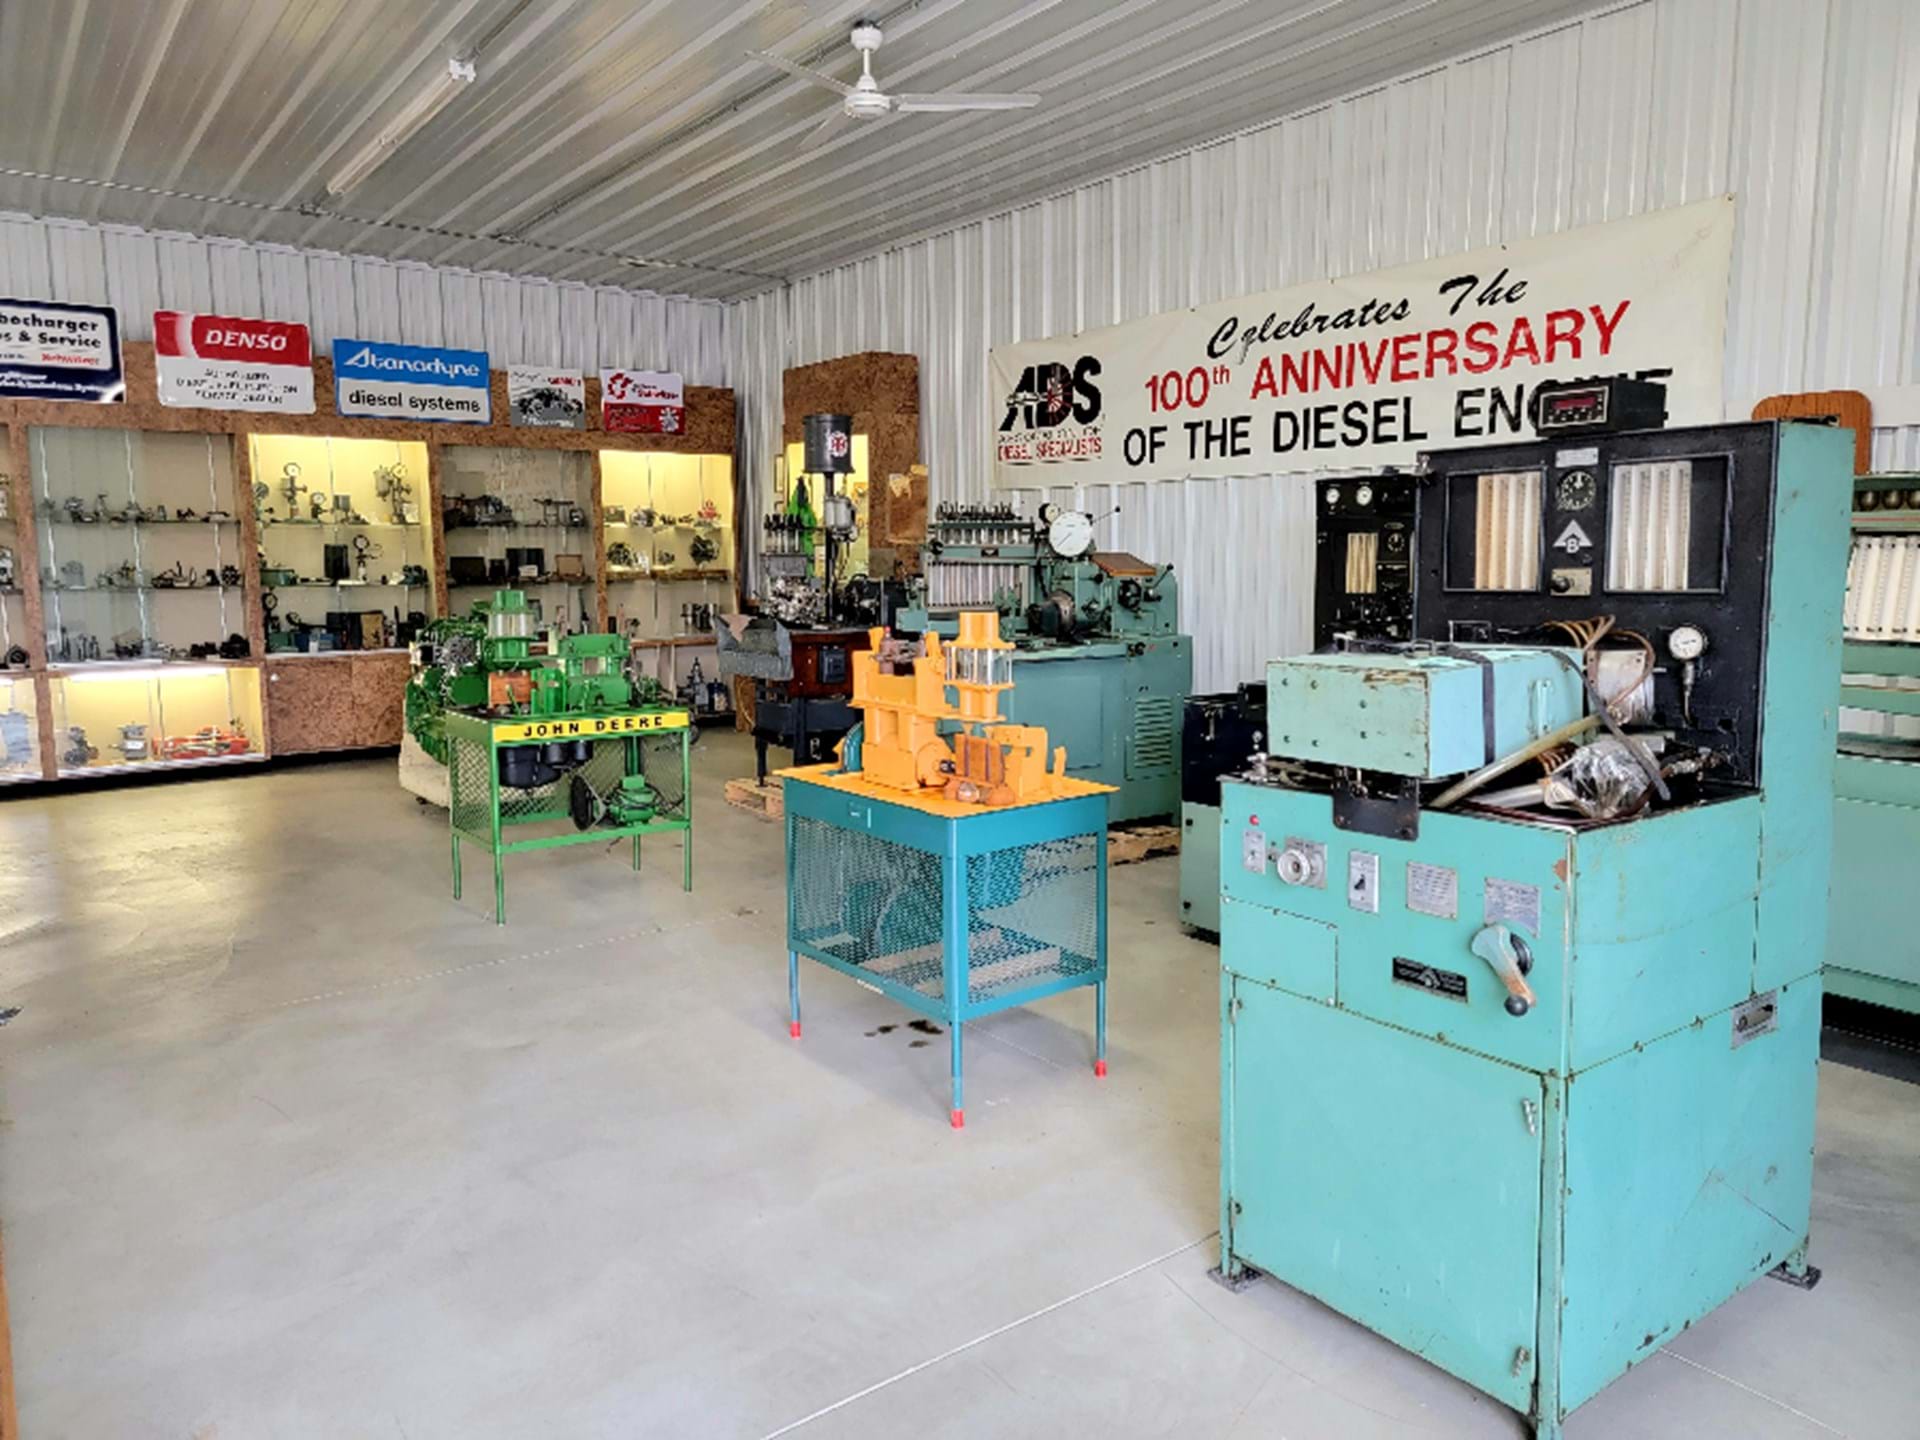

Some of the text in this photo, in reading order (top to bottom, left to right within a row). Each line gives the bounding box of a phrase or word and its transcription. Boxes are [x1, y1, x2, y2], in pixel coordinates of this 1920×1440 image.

[1206, 268, 1528, 359] Celebrates The
[18, 330, 31, 342] &
[38, 332, 101, 348] Service
[204, 329, 287, 351] DENSO
[1145, 299, 1631, 412] 100th ANNIVERSARY
[344, 346, 481, 379] Stanadyne
[348, 389, 481, 413] diesel systems
[998, 355, 1102, 432] ADS
[1123, 425, 1168, 466] OF
[1183, 415, 1252, 460] THE
[1272, 396, 1428, 453] DIESEL
[523, 716, 664, 737] JOHN DEERE
